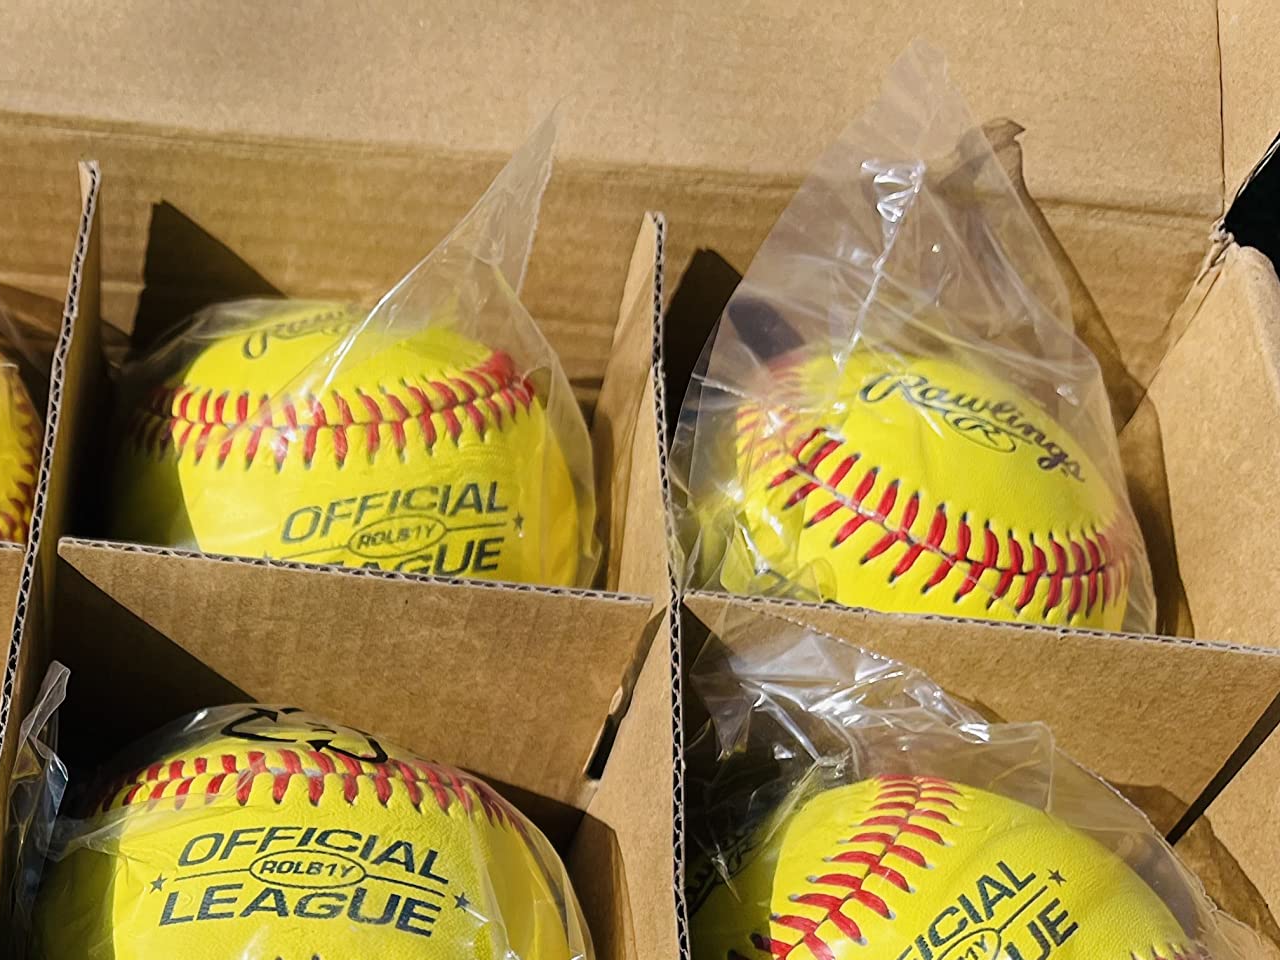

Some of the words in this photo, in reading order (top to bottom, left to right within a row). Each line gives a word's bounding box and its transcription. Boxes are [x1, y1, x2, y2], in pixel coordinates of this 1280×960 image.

[859, 372, 1085, 483] Rawlings
[280, 481, 508, 545] OFFICIAL
[177, 826, 449, 885] OFFICIAL
[259, 859, 355, 879] ROLB1Y
[158, 884, 443, 938] LEAGUE
